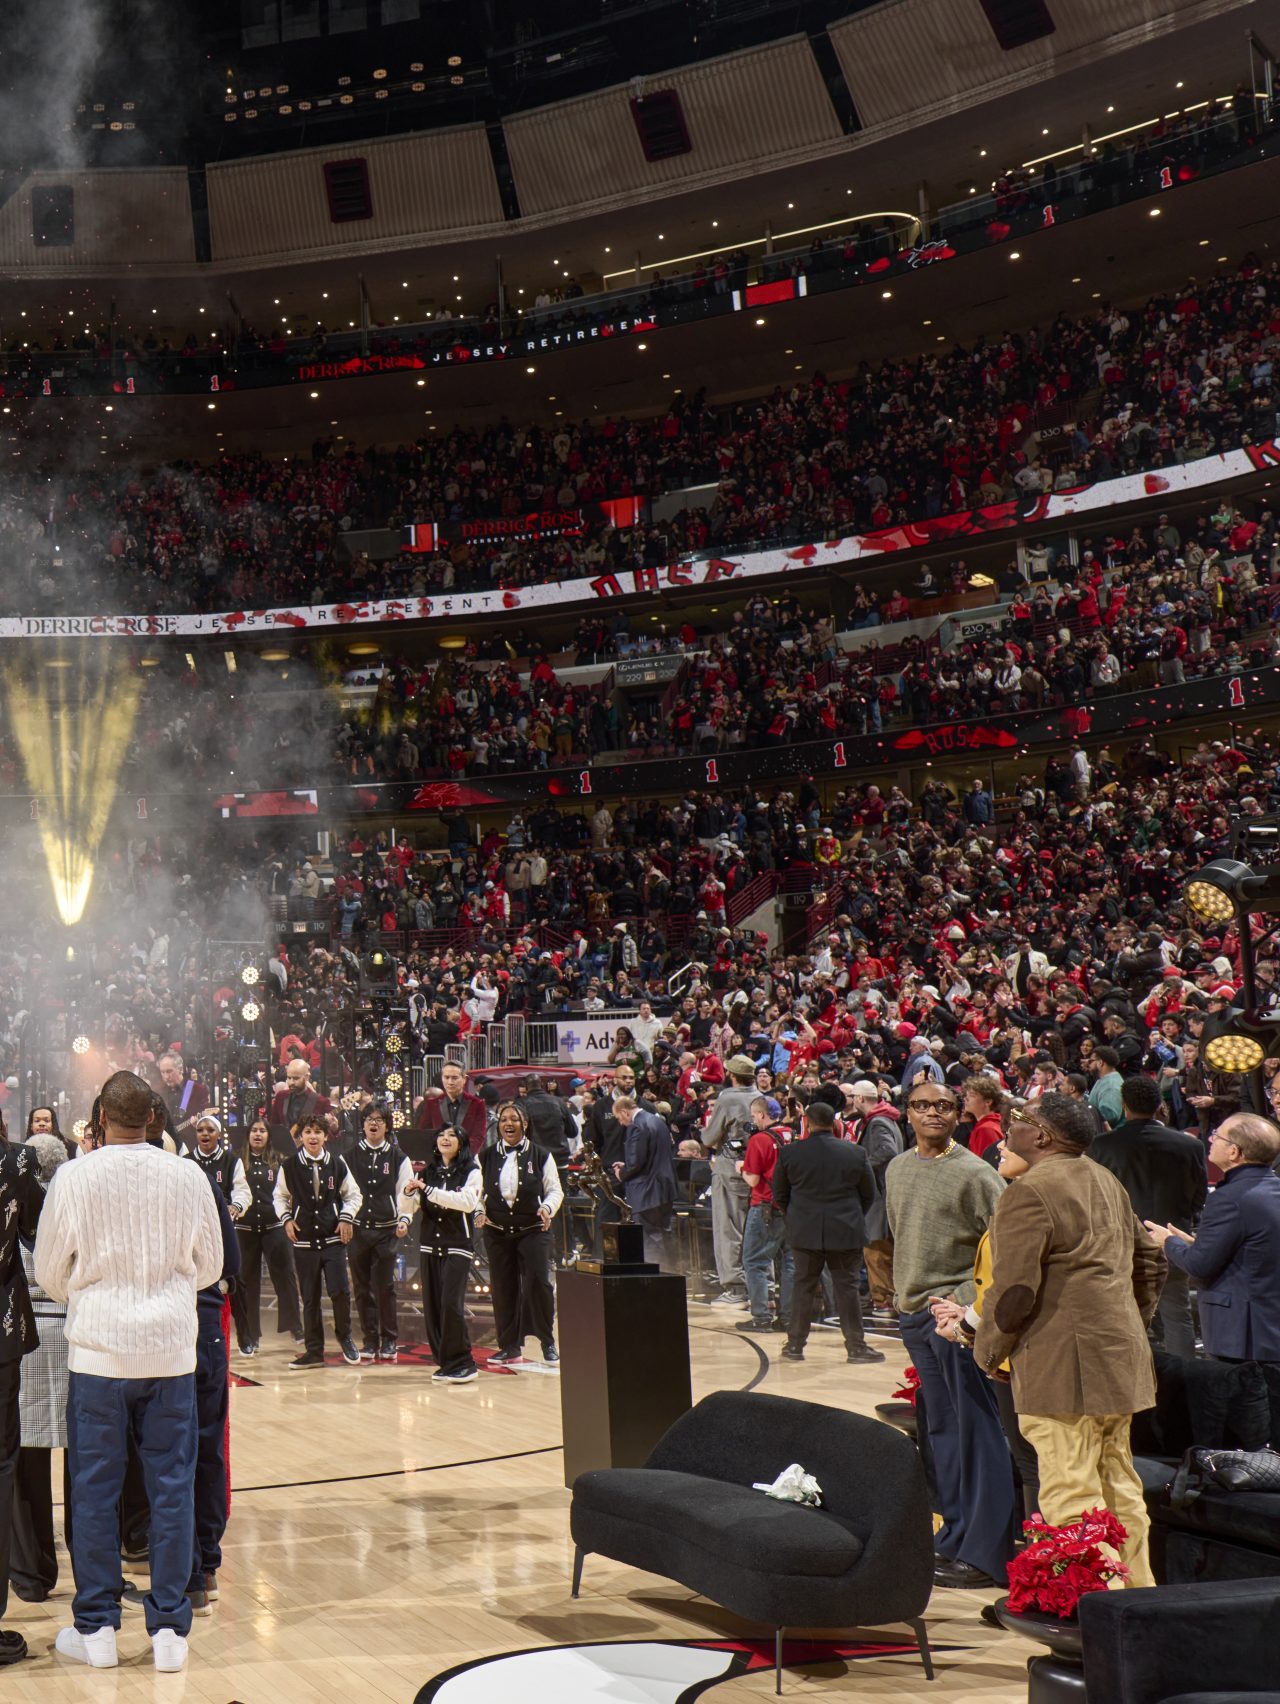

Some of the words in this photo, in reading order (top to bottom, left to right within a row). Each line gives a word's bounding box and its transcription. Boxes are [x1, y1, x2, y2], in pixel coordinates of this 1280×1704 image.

[1160, 167, 1173, 188] 1
[1043, 204, 1055, 224] 1
[433, 346, 508, 362] JERSEY
[42, 378, 51, 395] 1
[126, 377, 135, 393] 1
[210, 374, 219, 391] 1
[26, 618, 114, 635] DERRICK
[125, 616, 176, 634] ROSE
[195, 611, 293, 629] JESEY
[1228, 677, 1245, 706] 1
[833, 742, 846, 767] 1
[706, 758, 718, 782] 1
[579, 770, 592, 794] 1
[136, 798, 147, 819] 1
